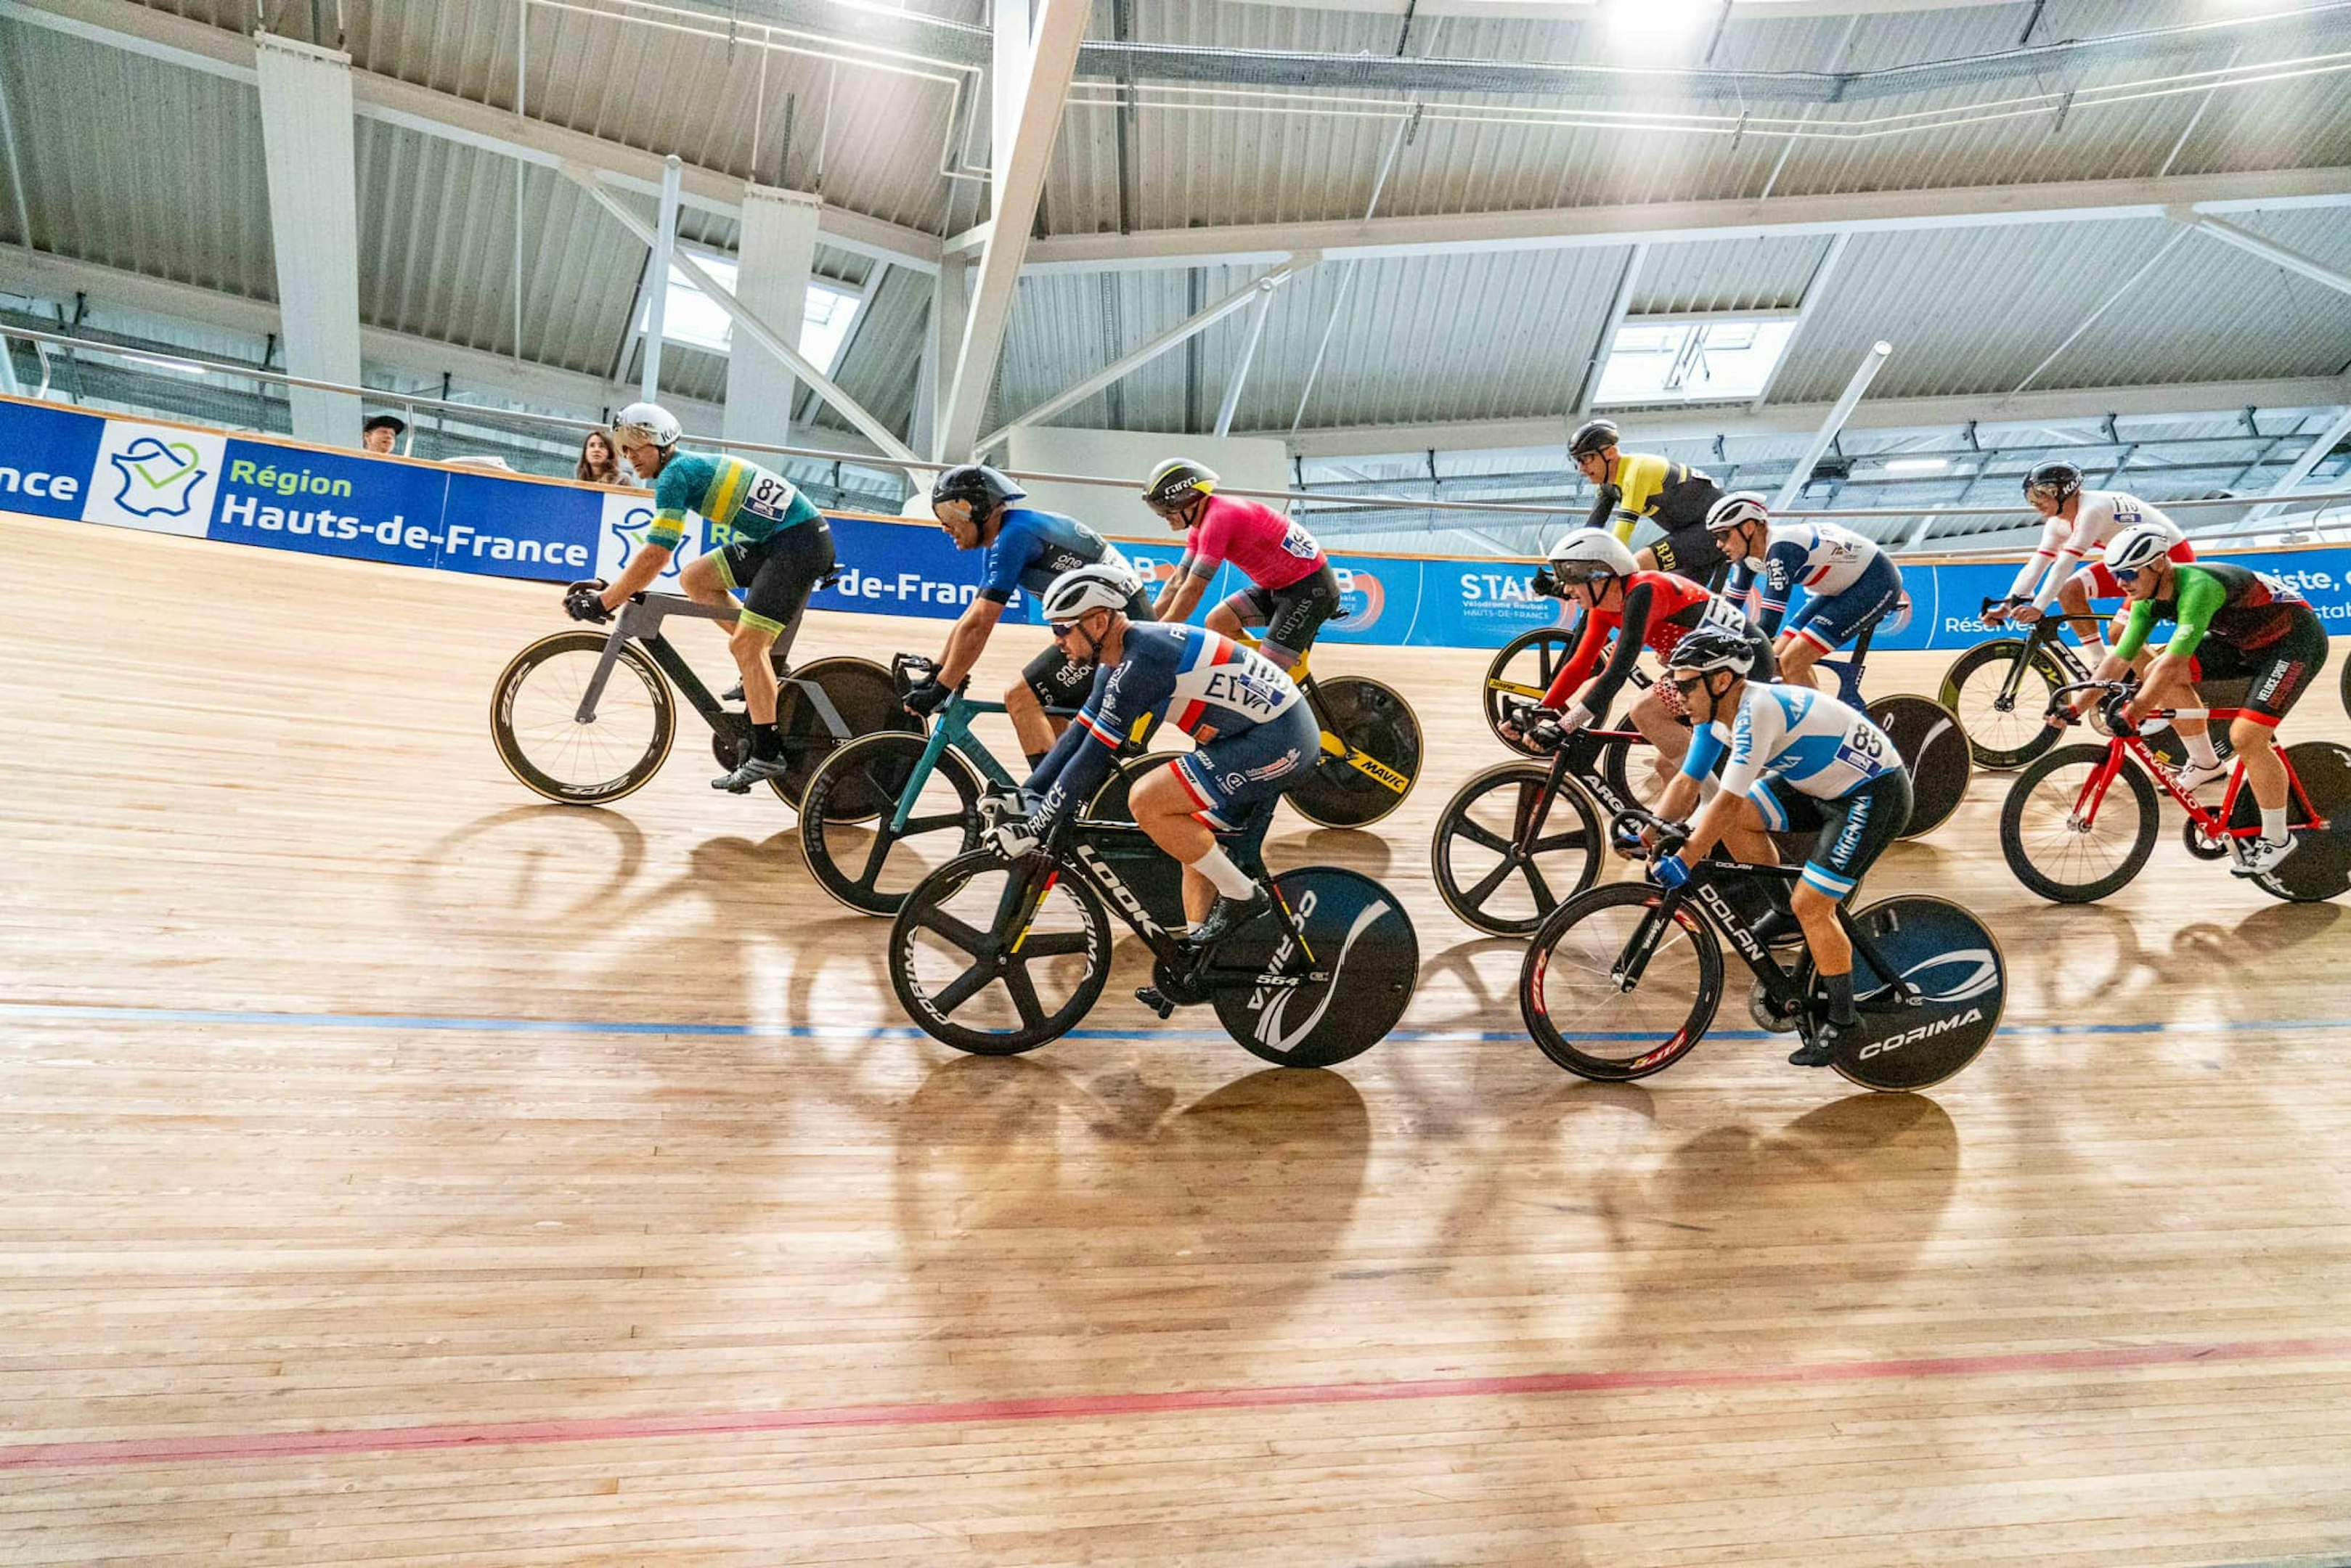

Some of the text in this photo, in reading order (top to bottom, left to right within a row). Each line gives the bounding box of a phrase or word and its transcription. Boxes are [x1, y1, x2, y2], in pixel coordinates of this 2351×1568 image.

[229, 460, 351, 497] Région
[756, 478, 786, 505] 87
[1165, 476, 1197, 495] GIRO
[220, 494, 589, 566] Hauts-de-France
[1057, 554, 1083, 568] one
[1853, 723, 1883, 758] 85
[1361, 761, 1404, 788] MAVIC
[2135, 741, 2199, 809] PINARELLO
[1027, 780, 1067, 836] FRANCE
[1828, 796, 1873, 870] ARGENTINA
[1077, 844, 1166, 939] LOOK
[1716, 861, 1753, 870] DOLAN
[1053, 883, 1098, 981] CORIMA
[1698, 883, 1764, 962] DOLAN
[904, 925, 950, 1024] CORIMA
[1859, 1007, 1982, 1061] CORIMA
